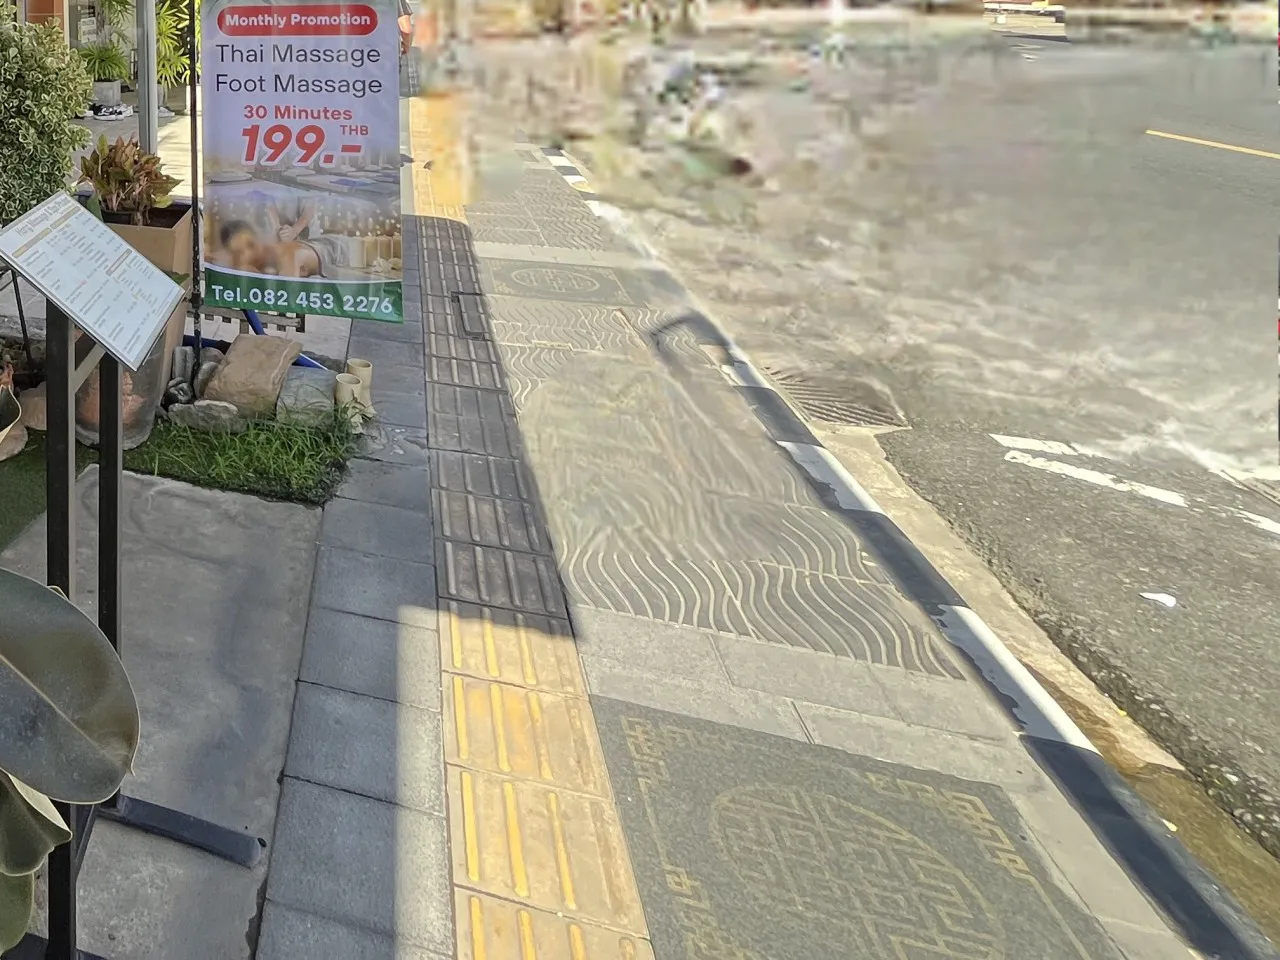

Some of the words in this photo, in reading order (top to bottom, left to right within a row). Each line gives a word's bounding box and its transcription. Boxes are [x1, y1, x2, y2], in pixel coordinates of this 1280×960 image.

[225, 14, 287, 28] Monthly
[291, 13, 371, 26] Promotion
[215, 44, 265, 63] Thai
[272, 44, 381, 67] Massage
[216, 74, 266, 93] Foot
[274, 74, 383, 98] Massage
[244, 105, 268, 119] 30
[274, 105, 353, 120] Minutes
[339, 124, 369, 136] THB
[295, 292, 334, 309] 453
[342, 295, 393, 313] 2276
